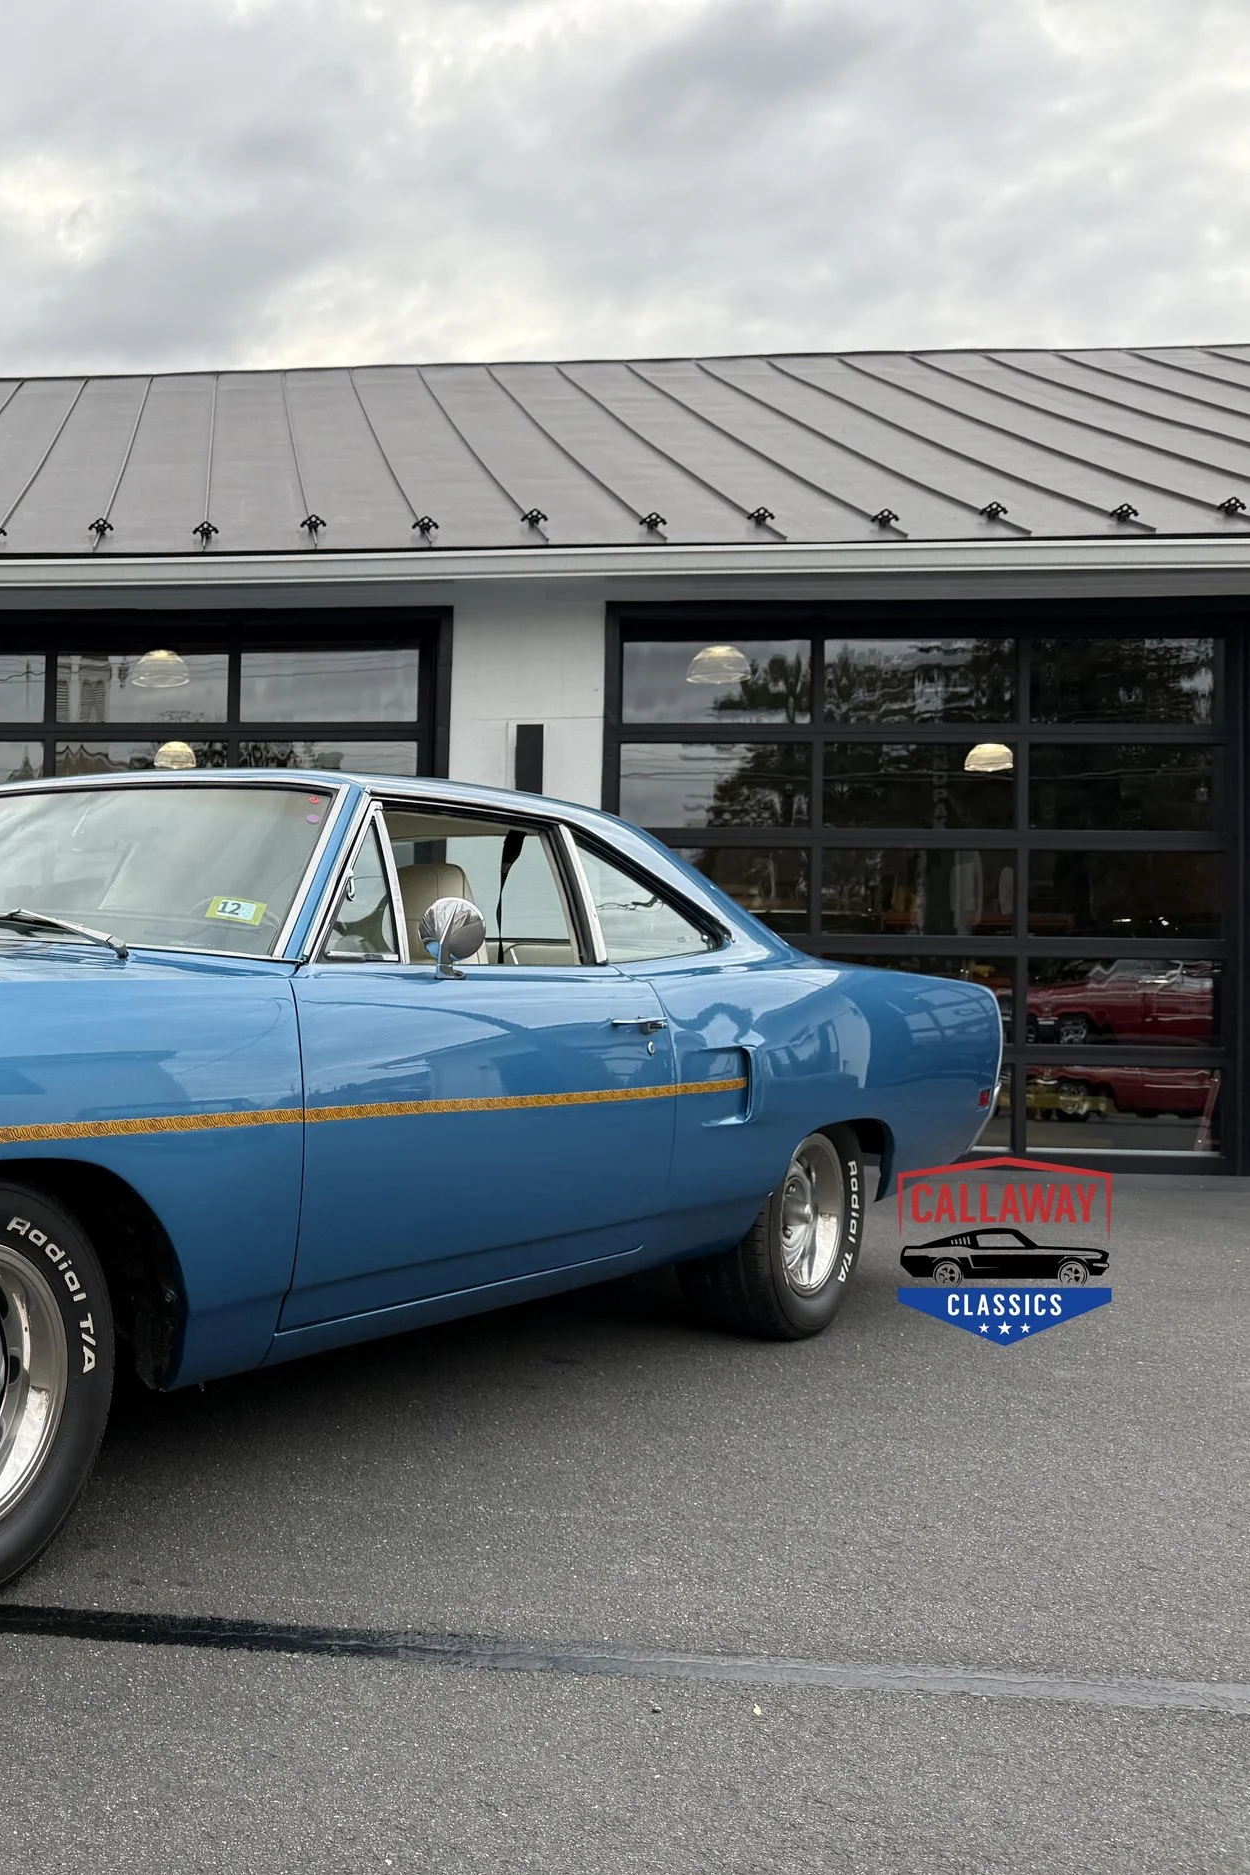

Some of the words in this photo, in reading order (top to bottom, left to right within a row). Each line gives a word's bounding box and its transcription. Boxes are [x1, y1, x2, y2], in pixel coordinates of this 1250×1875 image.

[217, 901, 242, 916] 12
[848, 1160, 860, 1244] Radial
[6, 1216, 87, 1303] Radial
[79, 1312, 97, 1374] T/A
[837, 1252, 853, 1283] T/A
